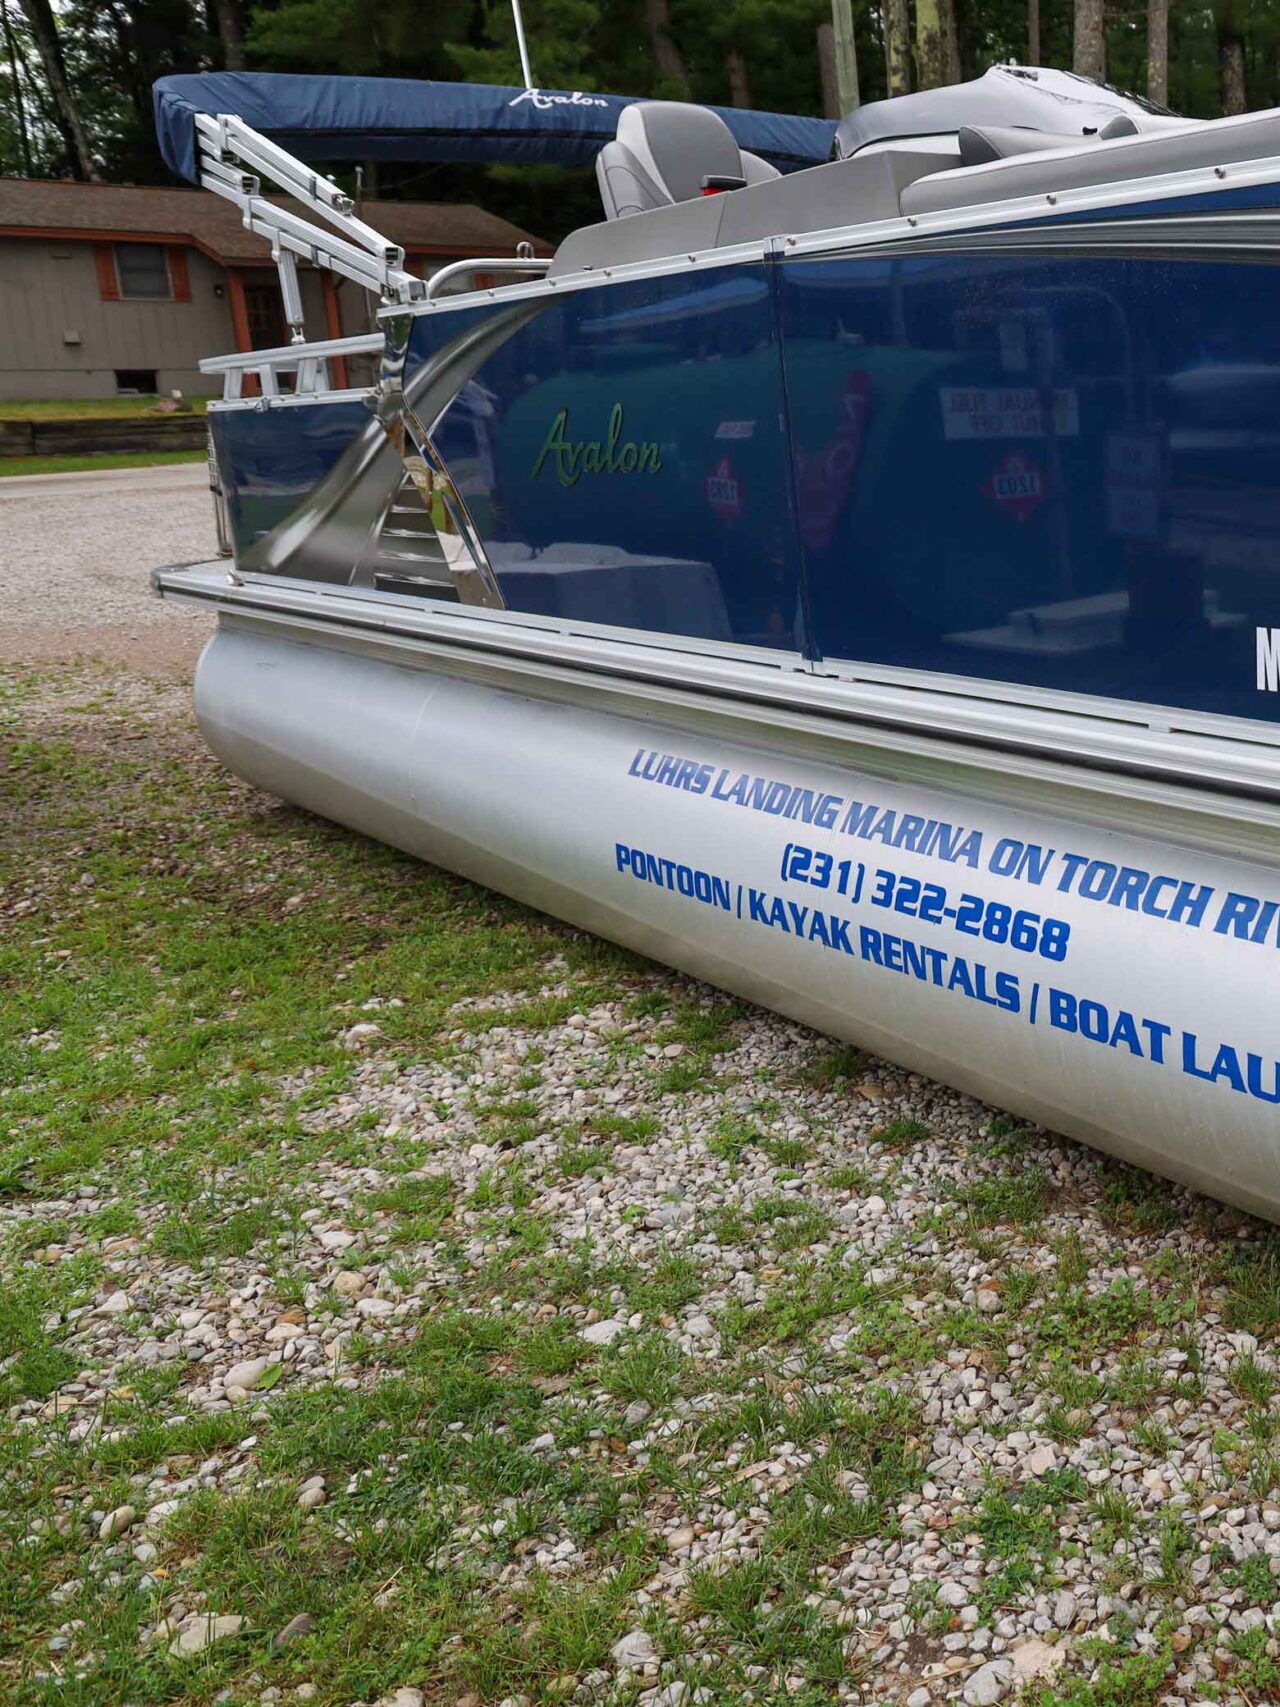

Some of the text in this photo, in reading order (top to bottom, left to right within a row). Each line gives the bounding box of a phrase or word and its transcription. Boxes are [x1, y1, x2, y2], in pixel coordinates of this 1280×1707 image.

[508, 88, 609, 110] Avalon
[531, 402, 662, 487] Avalon
[628, 748, 715, 795] LUHRS
[710, 769, 844, 830] LANDING
[841, 800, 984, 869] MARINA
[988, 838, 1056, 886] ON
[1057, 852, 1215, 929] TORCH
[614, 842, 732, 912] PONTOON
[747, 887, 855, 956] KAYAK
[858, 925, 1022, 1014] RENTALS
[1047, 987, 1173, 1065] BOAT
[780, 842, 1073, 964] (231) 322-2868
